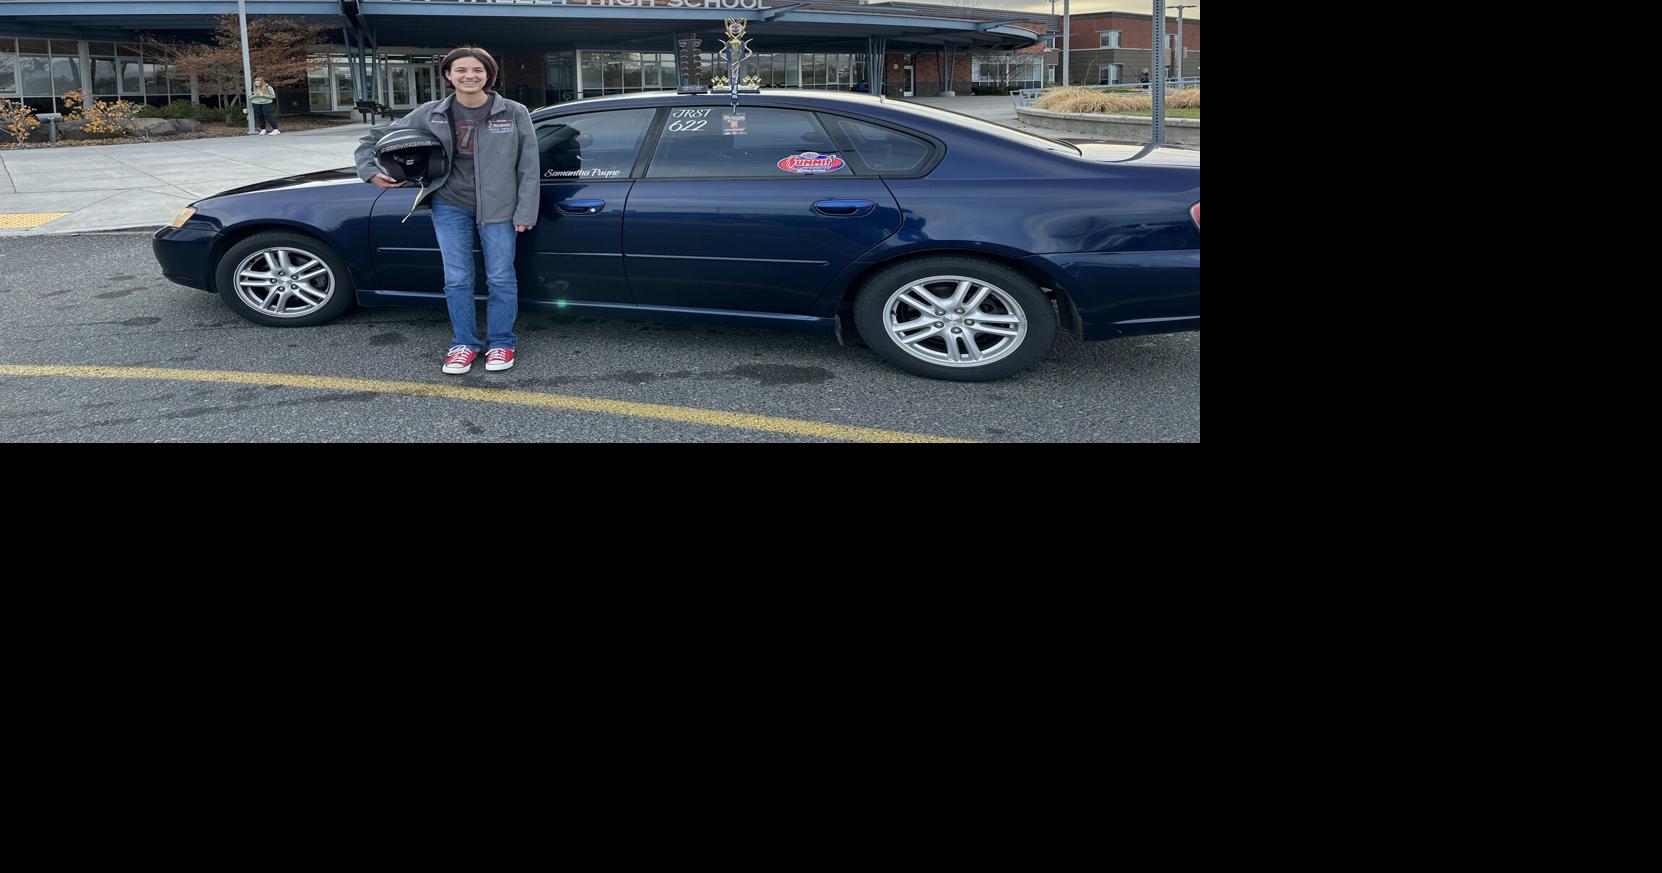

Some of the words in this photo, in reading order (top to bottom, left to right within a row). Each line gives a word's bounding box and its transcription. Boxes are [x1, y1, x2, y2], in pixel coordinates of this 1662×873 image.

[667, 0, 772, 9] SCHOOL
[668, 120, 708, 132] 622
[543, 168, 591, 178] Samantha
[591, 168, 620, 179] Payne
